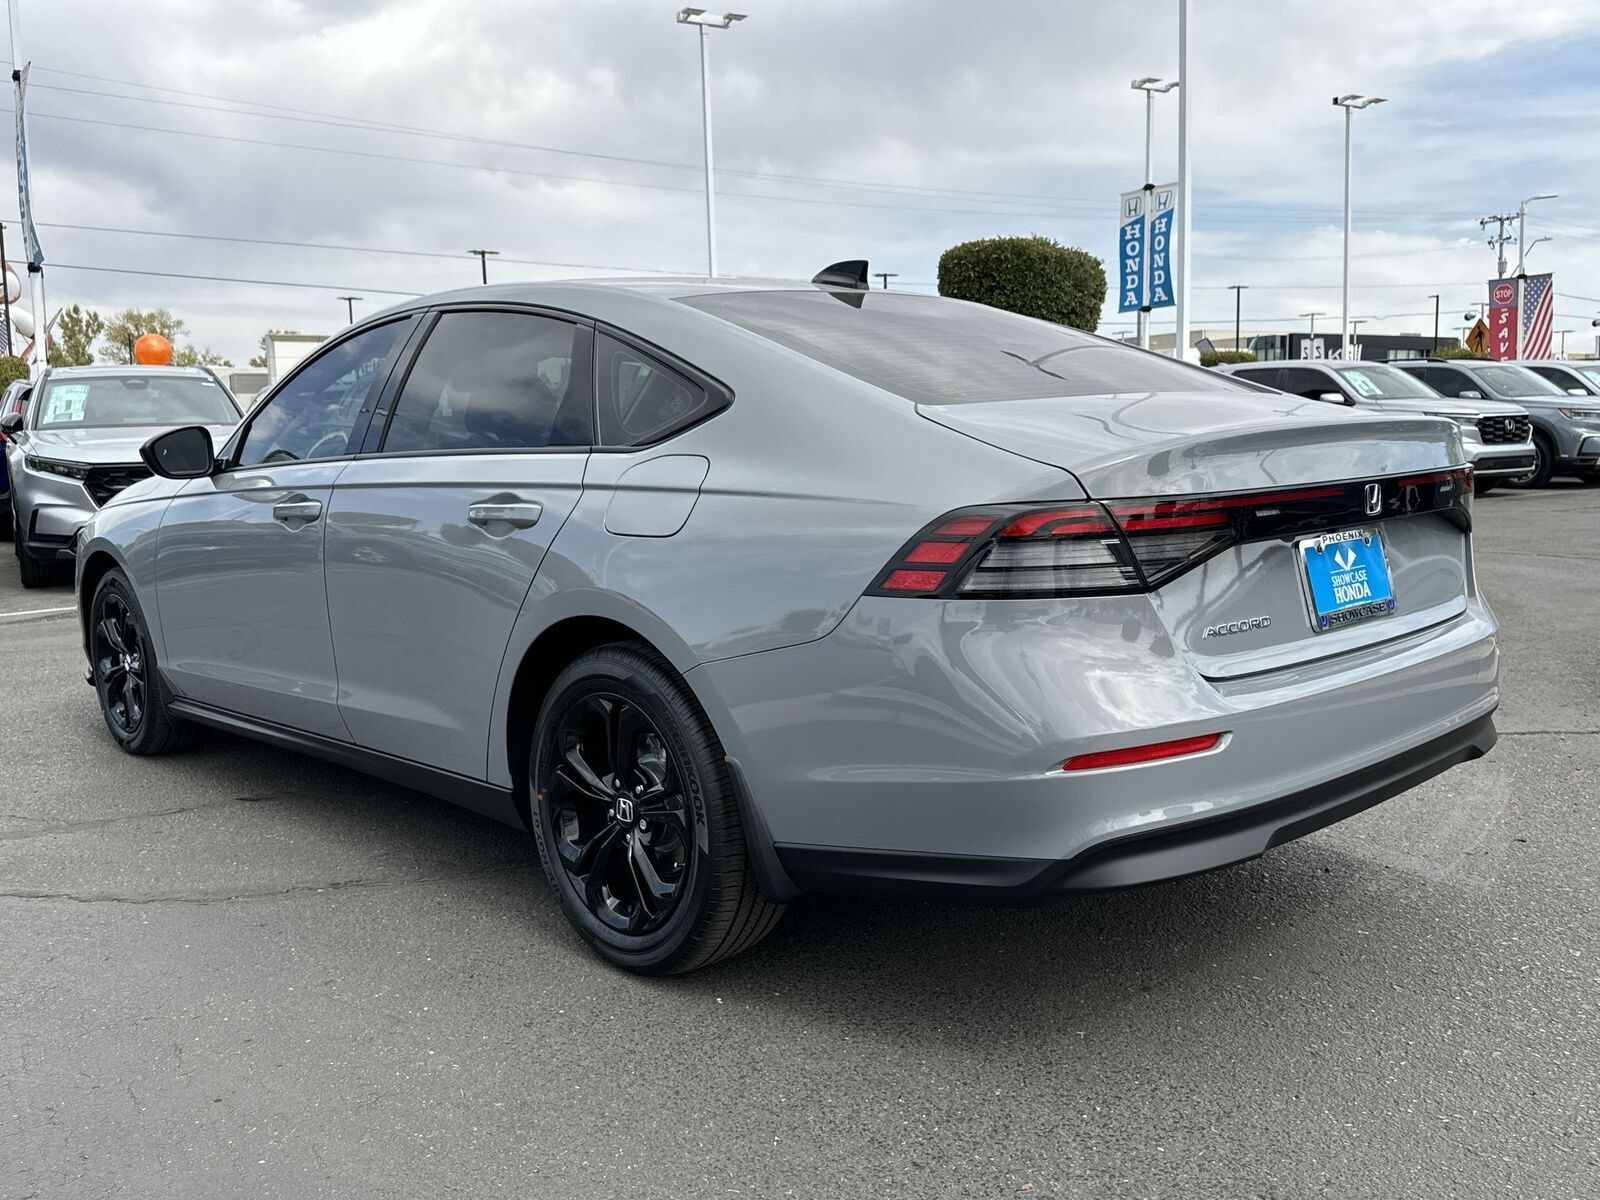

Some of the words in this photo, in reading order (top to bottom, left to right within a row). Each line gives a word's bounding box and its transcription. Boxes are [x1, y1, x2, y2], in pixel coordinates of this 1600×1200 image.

[1124, 223, 1141, 307] HONDA
[1153, 217, 1168, 303] HONDA
[1495, 290, 1513, 299] STOP
[1322, 529, 1363, 544] PHOENIX
[1331, 569, 1368, 587] SHOWCASE
[1333, 581, 1372, 604] HONDA
[1330, 602, 1387, 624] SHOWCASE
[1201, 615, 1272, 639] ACCORD
